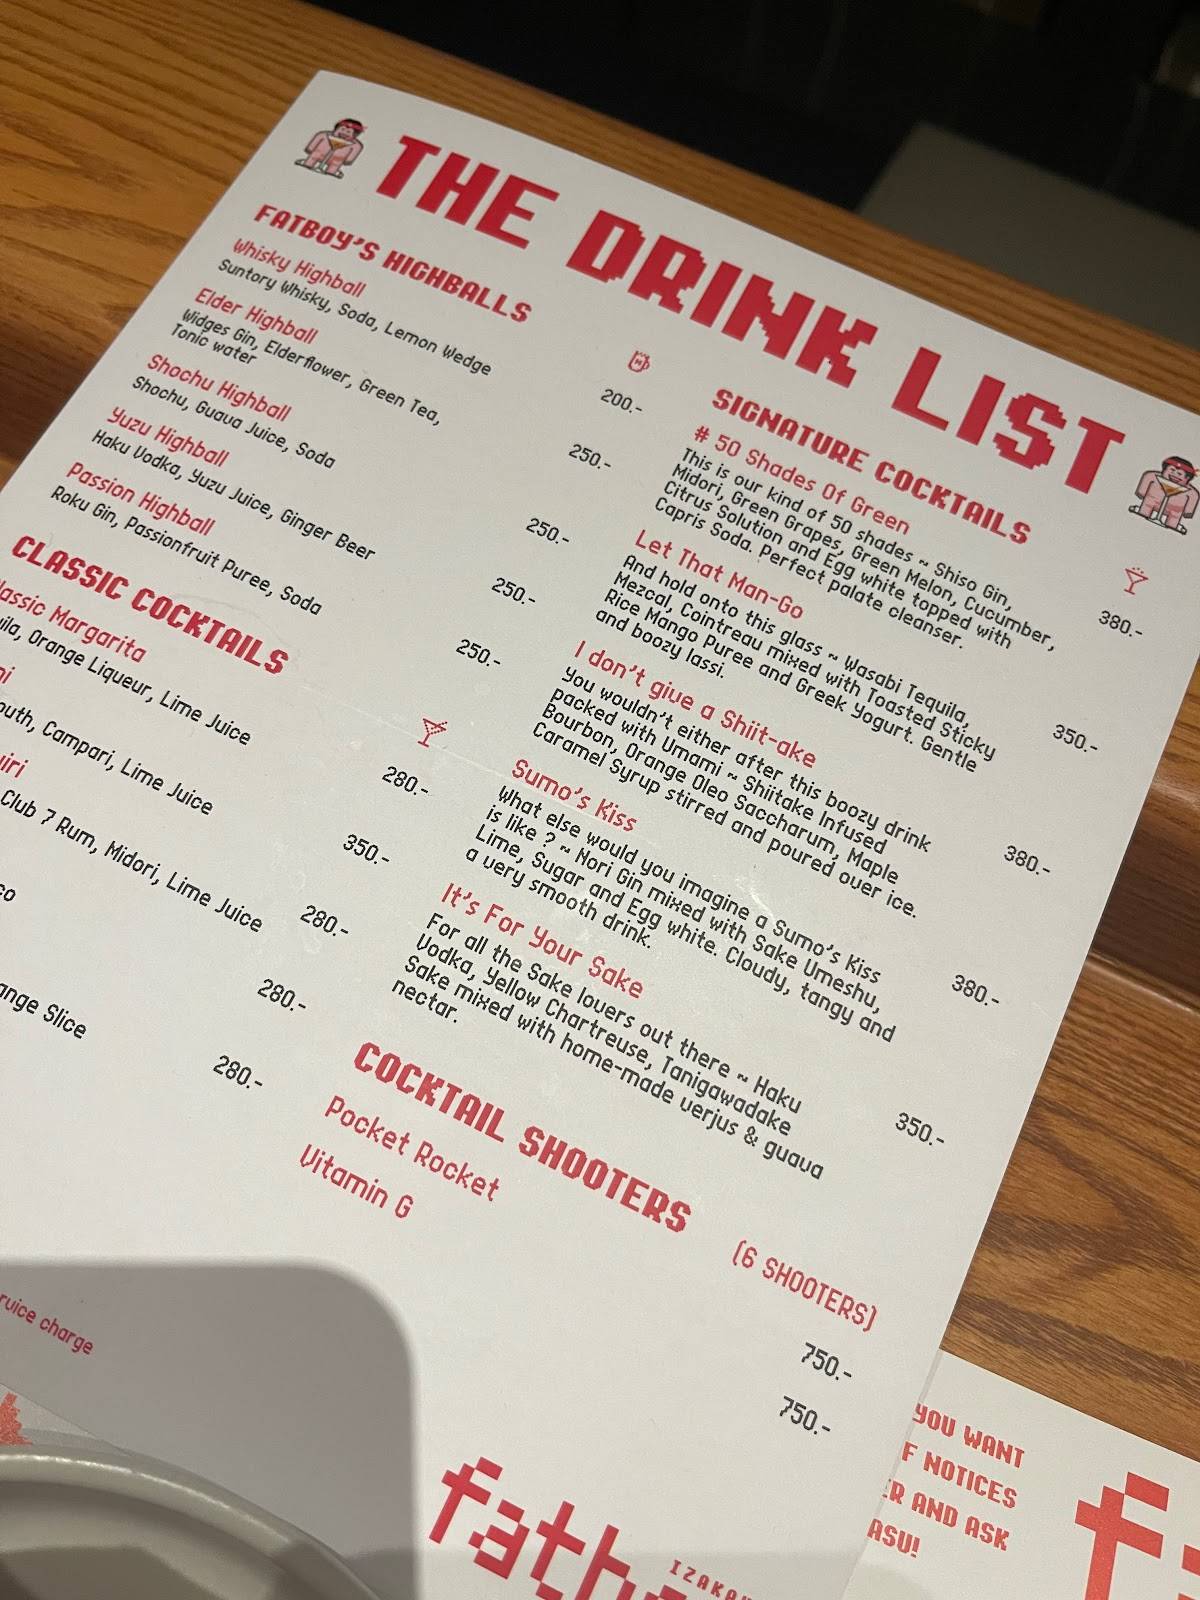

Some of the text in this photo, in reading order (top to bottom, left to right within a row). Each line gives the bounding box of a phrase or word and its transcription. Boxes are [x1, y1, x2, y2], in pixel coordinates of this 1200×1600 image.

[232, 237, 367, 298] Whisky Highball
[380, 248, 532, 323] HIGHBALLS
[170, 321, 258, 365] Tonic water
[193, 286, 319, 345] Elder Highball
[216, 257, 492, 376] Suntory Whisky, Soda, Lemon Wedge
[376, 135, 1125, 493] THE DRINK LIST
[146, 352, 293, 422] Shochu Highball
[181, 307, 440, 427] Widges Gin, Elderflower, Green Tea,
[131, 374, 336, 469] Shochu, Guava Juice, Soda
[599, 387, 643, 414] 200.-
[105, 405, 230, 468] Yuzu Highball
[567, 442, 612, 470] 250.-
[710, 387, 1032, 545] SIGNATURE COCKTAILS
[64, 460, 217, 537] Passion Highball
[90, 427, 376, 560] Haku Vodka, Yuzu Juice, Ginger Beer
[693, 424, 910, 536] # 50 Shades Of Green
[49, 483, 323, 616] Roku Gin, Passionfruit Puree, Soda
[524, 516, 570, 545] 250.-
[670, 462, 1055, 652] Midori, Green Grapes, Green Melon, Cucumber,
[10, 534, 289, 675] CLASSIC COCKTAILS
[490, 576, 536, 605] 250.-
[633, 527, 804, 619] Let That Man-Go
[47, 604, 147, 664] Margarita
[454, 637, 501, 667] 250.-
[594, 608, 725, 679] and boozy lassi.
[1097, 608, 1143, 638] 380.-
[26, 628, 86, 667] Orange
[85, 654, 154, 704] Liqueur,
[157, 689, 203, 723] Lime
[203, 712, 251, 746] Juice
[573, 639, 586, 658] I
[647, 680, 695, 711] give
[699, 703, 716, 721] a
[719, 708, 817, 769] Shiit-ake
[41, 719, 116, 772] Campari,
[119, 756, 164, 792] Lime
[165, 781, 214, 816] Juice
[1051, 723, 1098, 753] 350.-
[380, 764, 429, 796] 280.-
[540, 701, 899, 885] Bourbon, Orange Oleo Saccharum, Maple
[593, 796, 638, 832] Kiss
[0, 788, 263, 933] Club 7 Rum, Midori, Lime Juice
[341, 832, 390, 865] 350.-
[1002, 843, 1051, 876] 380.-
[298, 903, 349, 937] 280.-
[464, 847, 651, 949] a very smooth drink.
[482, 902, 525, 937] For
[527, 924, 584, 966] Your
[587, 954, 644, 999] Sake
[41, 1002, 87, 1040] Slice
[255, 977, 307, 1012] 280.-
[390, 978, 458, 1024] nectar.
[950, 973, 1000, 1007] 380.-
[415, 931, 792, 1137] Vodka, Yellow Chartreuse, Tanigawadake
[211, 1053, 263, 1089] 280.-
[403, 953, 824, 1180] Sake mixed with home-made verjus & guava
[323, 1094, 500, 1202] Pocket Rocket
[352, 1040, 692, 1233] COCKTAIL SHOOTERS
[894, 1110, 945, 1146] 350.-
[298, 1142, 414, 1219] Vitamin G
[731, 1238, 878, 1333] (6 SHOOTERS)
[39, 1317, 94, 1355] charge
[799, 1340, 852, 1381] 750.-
[778, 1394, 831, 1436] 750.-
[911, 1402, 1025, 1468] YOU WANT
[923, 1451, 1018, 1509] NOTICES
[911, 1491, 959, 1528] AND
[964, 1515, 1010, 1551] ASK
[669, 1559, 752, 1600] IZAKA
